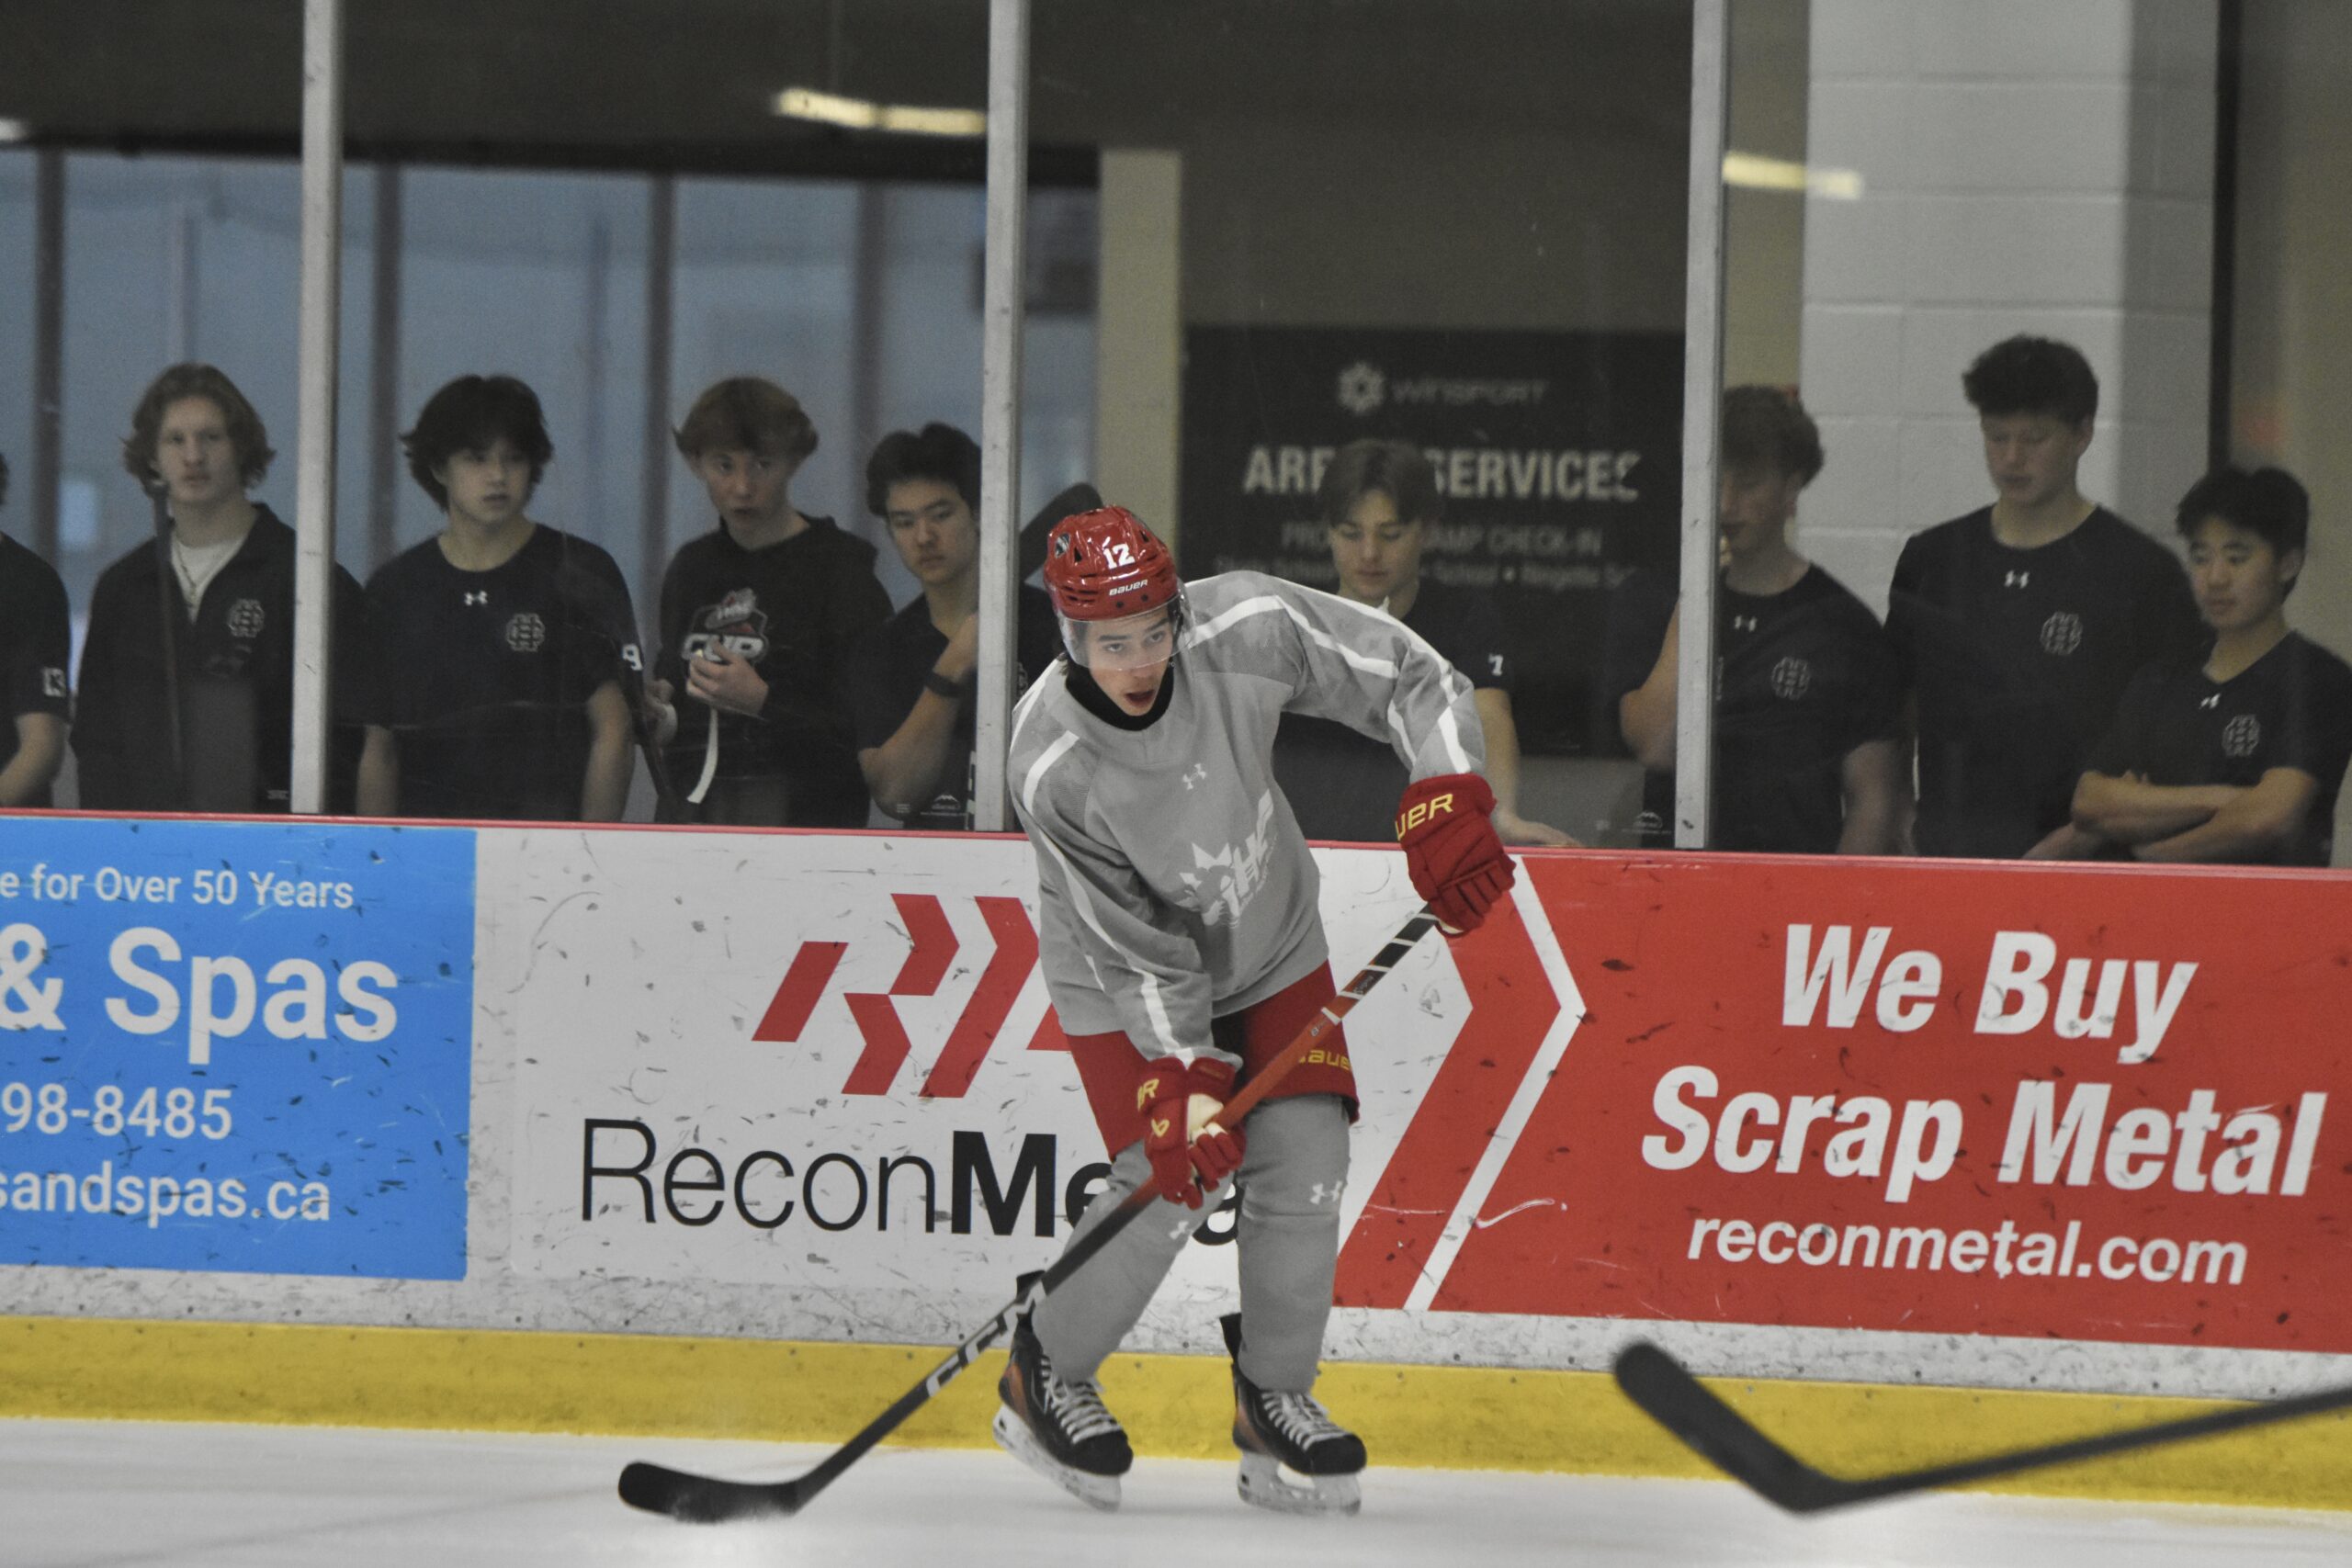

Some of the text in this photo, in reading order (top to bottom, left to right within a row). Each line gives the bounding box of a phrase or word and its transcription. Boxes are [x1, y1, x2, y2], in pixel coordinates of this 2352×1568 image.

[1102, 543, 1136, 570] 12
[623, 644, 643, 671] 9
[31, 863, 85, 900] for
[95, 866, 182, 903] Over
[192, 871, 238, 905] 50
[249, 872, 355, 908] Years
[0, 922, 399, 1065] & Spas
[1782, 923, 2199, 1065] We Buy
[2, 1082, 233, 1140] 98-8485
[1641, 1066, 2328, 1203] Scrap Metal
[0, 1160, 331, 1229] andspas.ca
[1687, 1218, 2248, 1285] reconmetal.com
